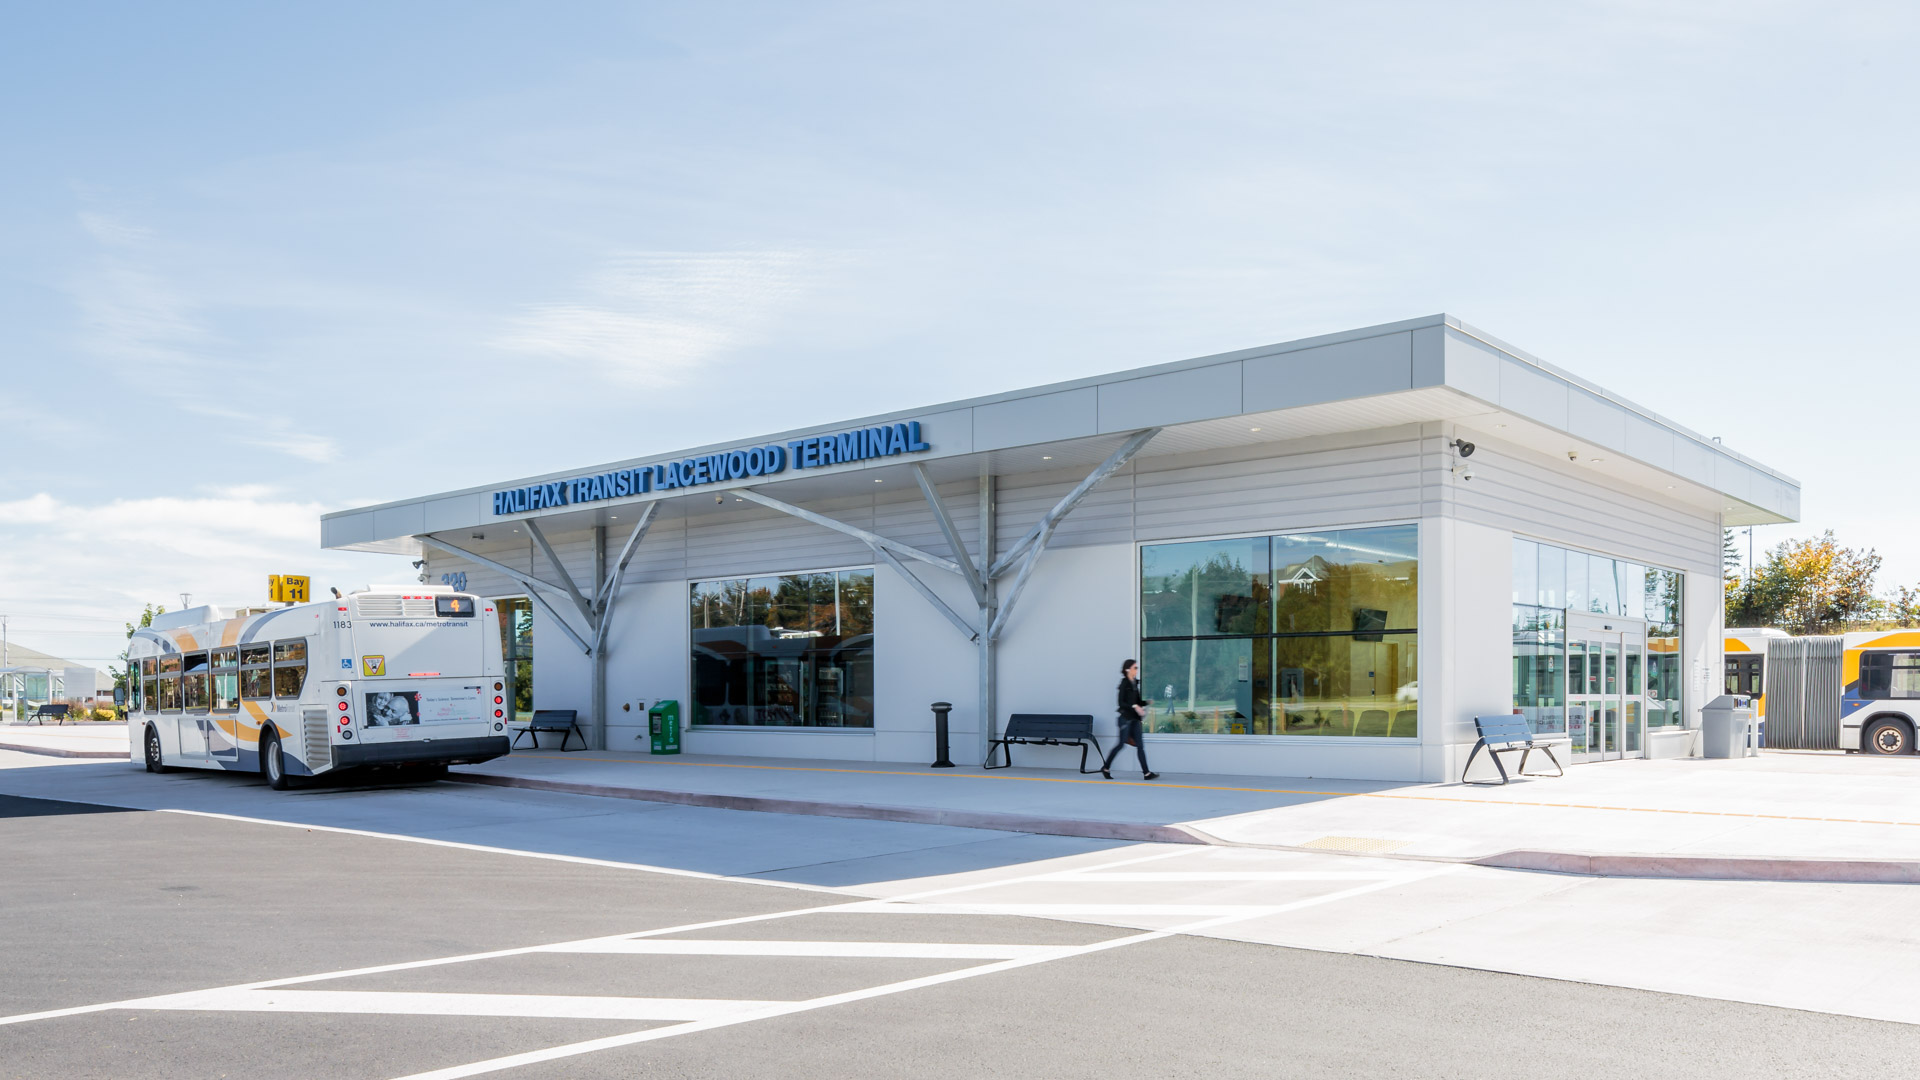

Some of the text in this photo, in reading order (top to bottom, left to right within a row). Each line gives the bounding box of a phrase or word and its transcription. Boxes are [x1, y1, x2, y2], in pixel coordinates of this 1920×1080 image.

[493, 421, 930, 515] HALIFAX TRANSIT LACEWOOD TERMINAL
[286, 577, 305, 588] Bay
[289, 588, 303, 599] 11
[450, 599, 460, 612] 4
[333, 620, 352, 629] 1183
[369, 620, 469, 628] www.halifax.ca/metrotransit
